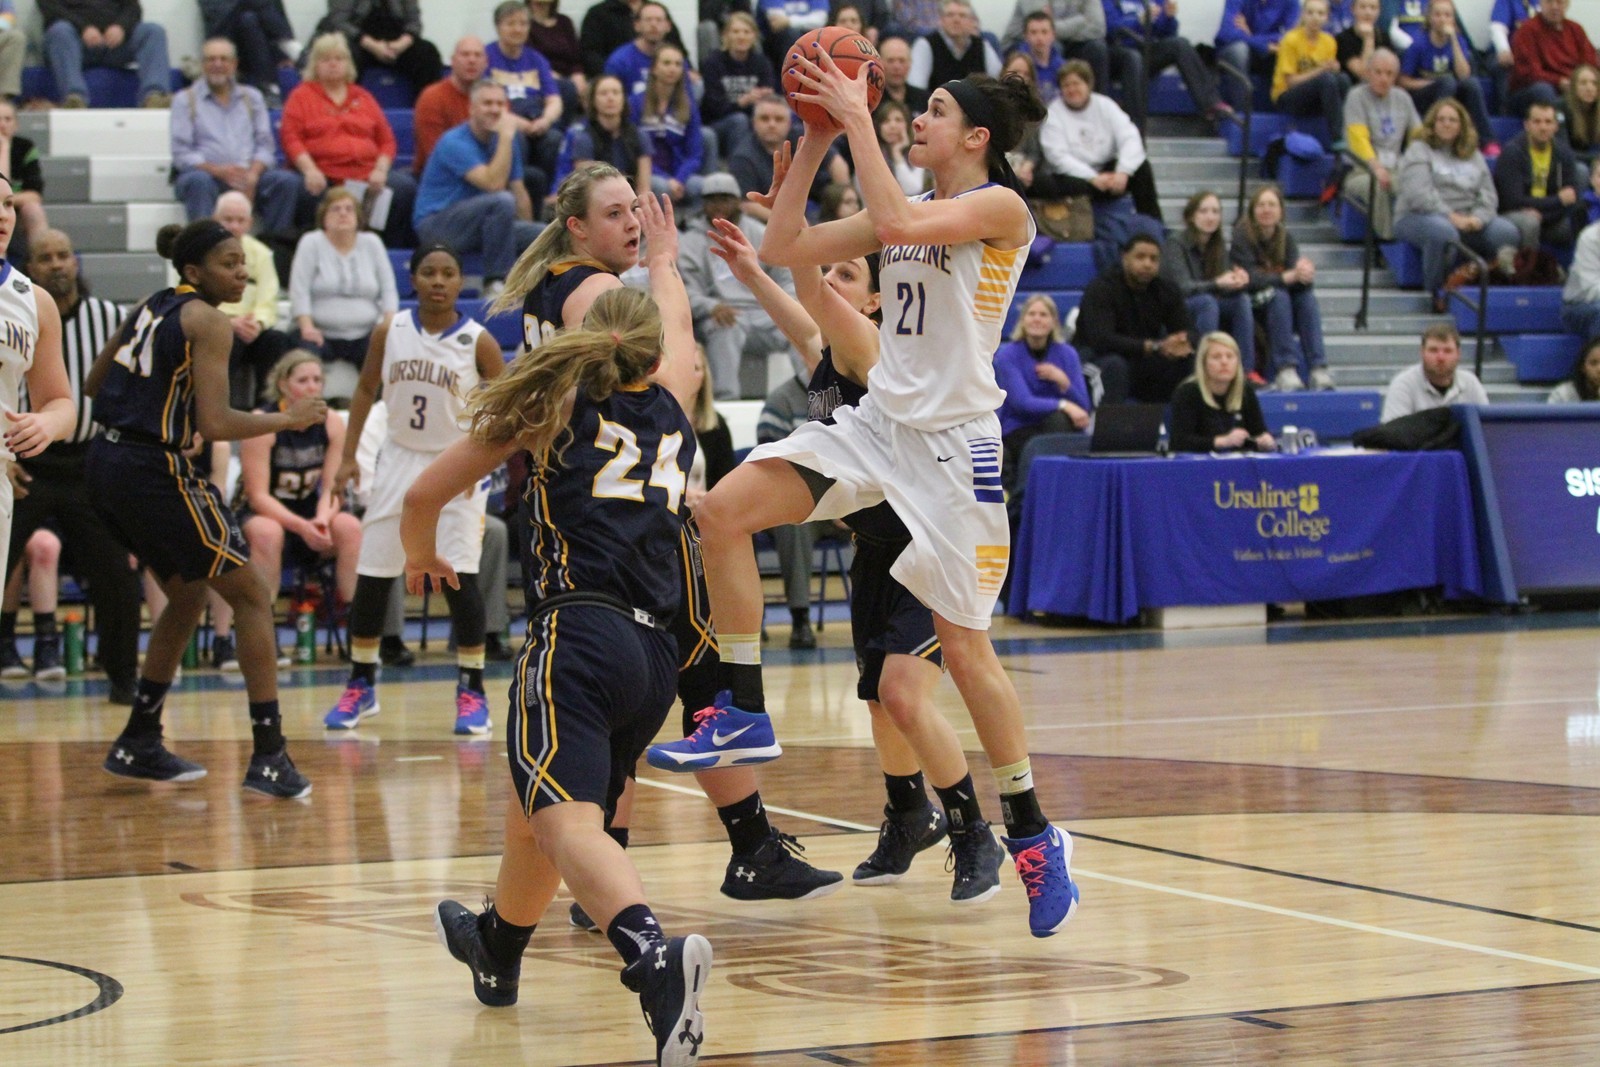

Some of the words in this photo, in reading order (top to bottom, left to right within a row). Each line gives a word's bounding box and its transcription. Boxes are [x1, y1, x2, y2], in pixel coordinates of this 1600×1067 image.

[896, 281, 925, 335] 21
[410, 394, 427, 431] 3
[592, 412, 686, 516] 24
[1213, 480, 1298, 509] Ursuline
[1256, 509, 1331, 542] College
